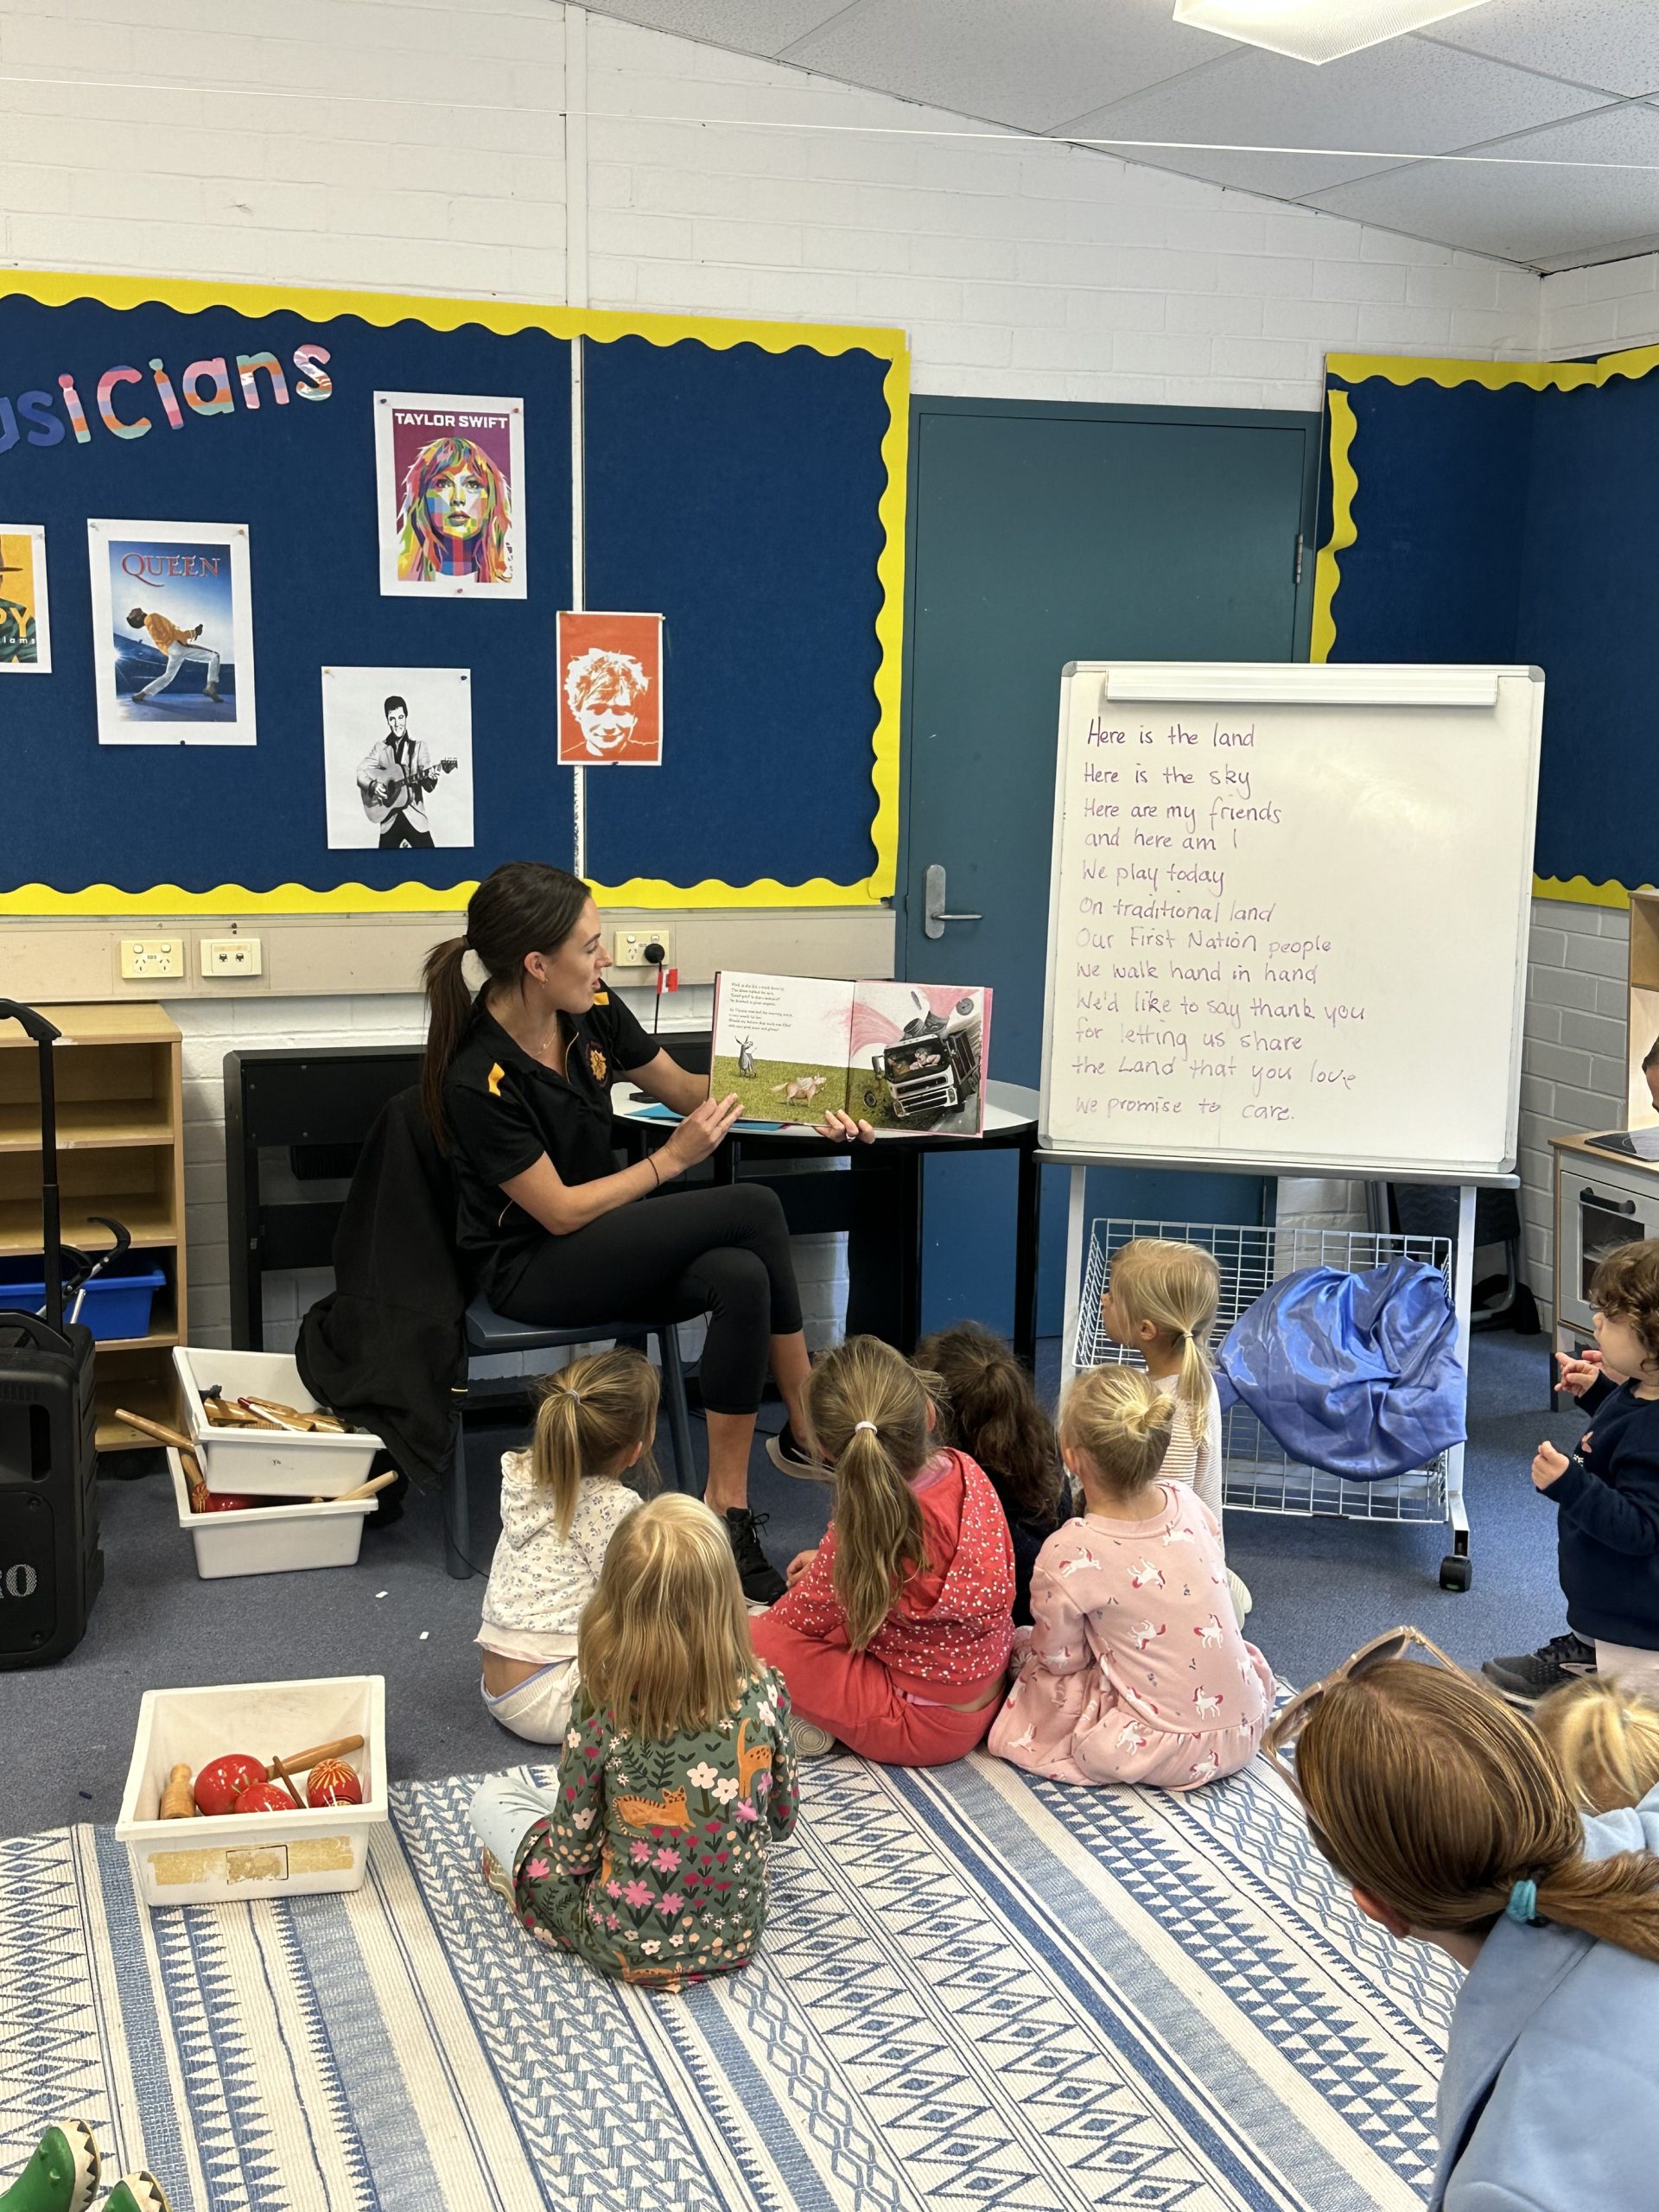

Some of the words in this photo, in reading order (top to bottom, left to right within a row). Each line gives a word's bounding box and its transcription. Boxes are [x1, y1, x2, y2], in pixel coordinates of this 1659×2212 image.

[395, 412, 455, 428] TAYLOR
[459, 415, 508, 429] SWIFT
[122, 552, 220, 588] QUEEN
[1087, 716, 1125, 747] Here
[1140, 725, 1154, 744] is
[1168, 724, 1198, 745] the
[1213, 722, 1255, 747] land
[1084, 762, 1120, 783] Here
[1135, 763, 1147, 784] is
[1163, 766, 1195, 785] the
[1210, 764, 1250, 800] sky
[1084, 798, 1120, 817] Here
[1131, 804, 1157, 817] are
[1166, 805, 1196, 834] my
[1209, 794, 1282, 830] friends
[1084, 827, 1120, 847] and
[1135, 828, 1173, 848] here
[1183, 836, 1217, 850] am
[1083, 859, 1108, 880] We
[1116, 863, 1159, 892] play
[1166, 863, 1224, 898] today
[1080, 898, 1103, 915] On
[1113, 893, 1220, 923] traditional
[1230, 899, 1276, 923] land
[1076, 928, 1114, 949] Our
[1130, 927, 1175, 949] First
[1189, 931, 1256, 952] Nation
[1269, 935, 1332, 960] people
[1113, 960, 1159, 979] walk
[1171, 961, 1221, 982] hand
[1233, 965, 1250, 982] in
[1265, 962, 1318, 985] hand
[1077, 990, 1119, 1013] We'd
[1135, 990, 1172, 1013] like
[1180, 995, 1199, 1014] to
[1207, 1001, 1241, 1029] say
[1250, 997, 1315, 1019] thank
[1325, 1007, 1365, 1028] you
[1076, 1017, 1103, 1039] for
[1121, 1020, 1187, 1061] letting
[1204, 1033, 1225, 1047] us
[1241, 1031, 1303, 1052] share
[1071, 1057, 1105, 1076] the
[1118, 1056, 1176, 1074] Land
[1191, 1056, 1237, 1078] that
[1252, 1065, 1292, 1097] you
[1310, 1059, 1356, 1090] love
[1108, 1096, 1182, 1118] promise
[1198, 1099, 1221, 1113] to
[1243, 1104, 1295, 1121] care.
